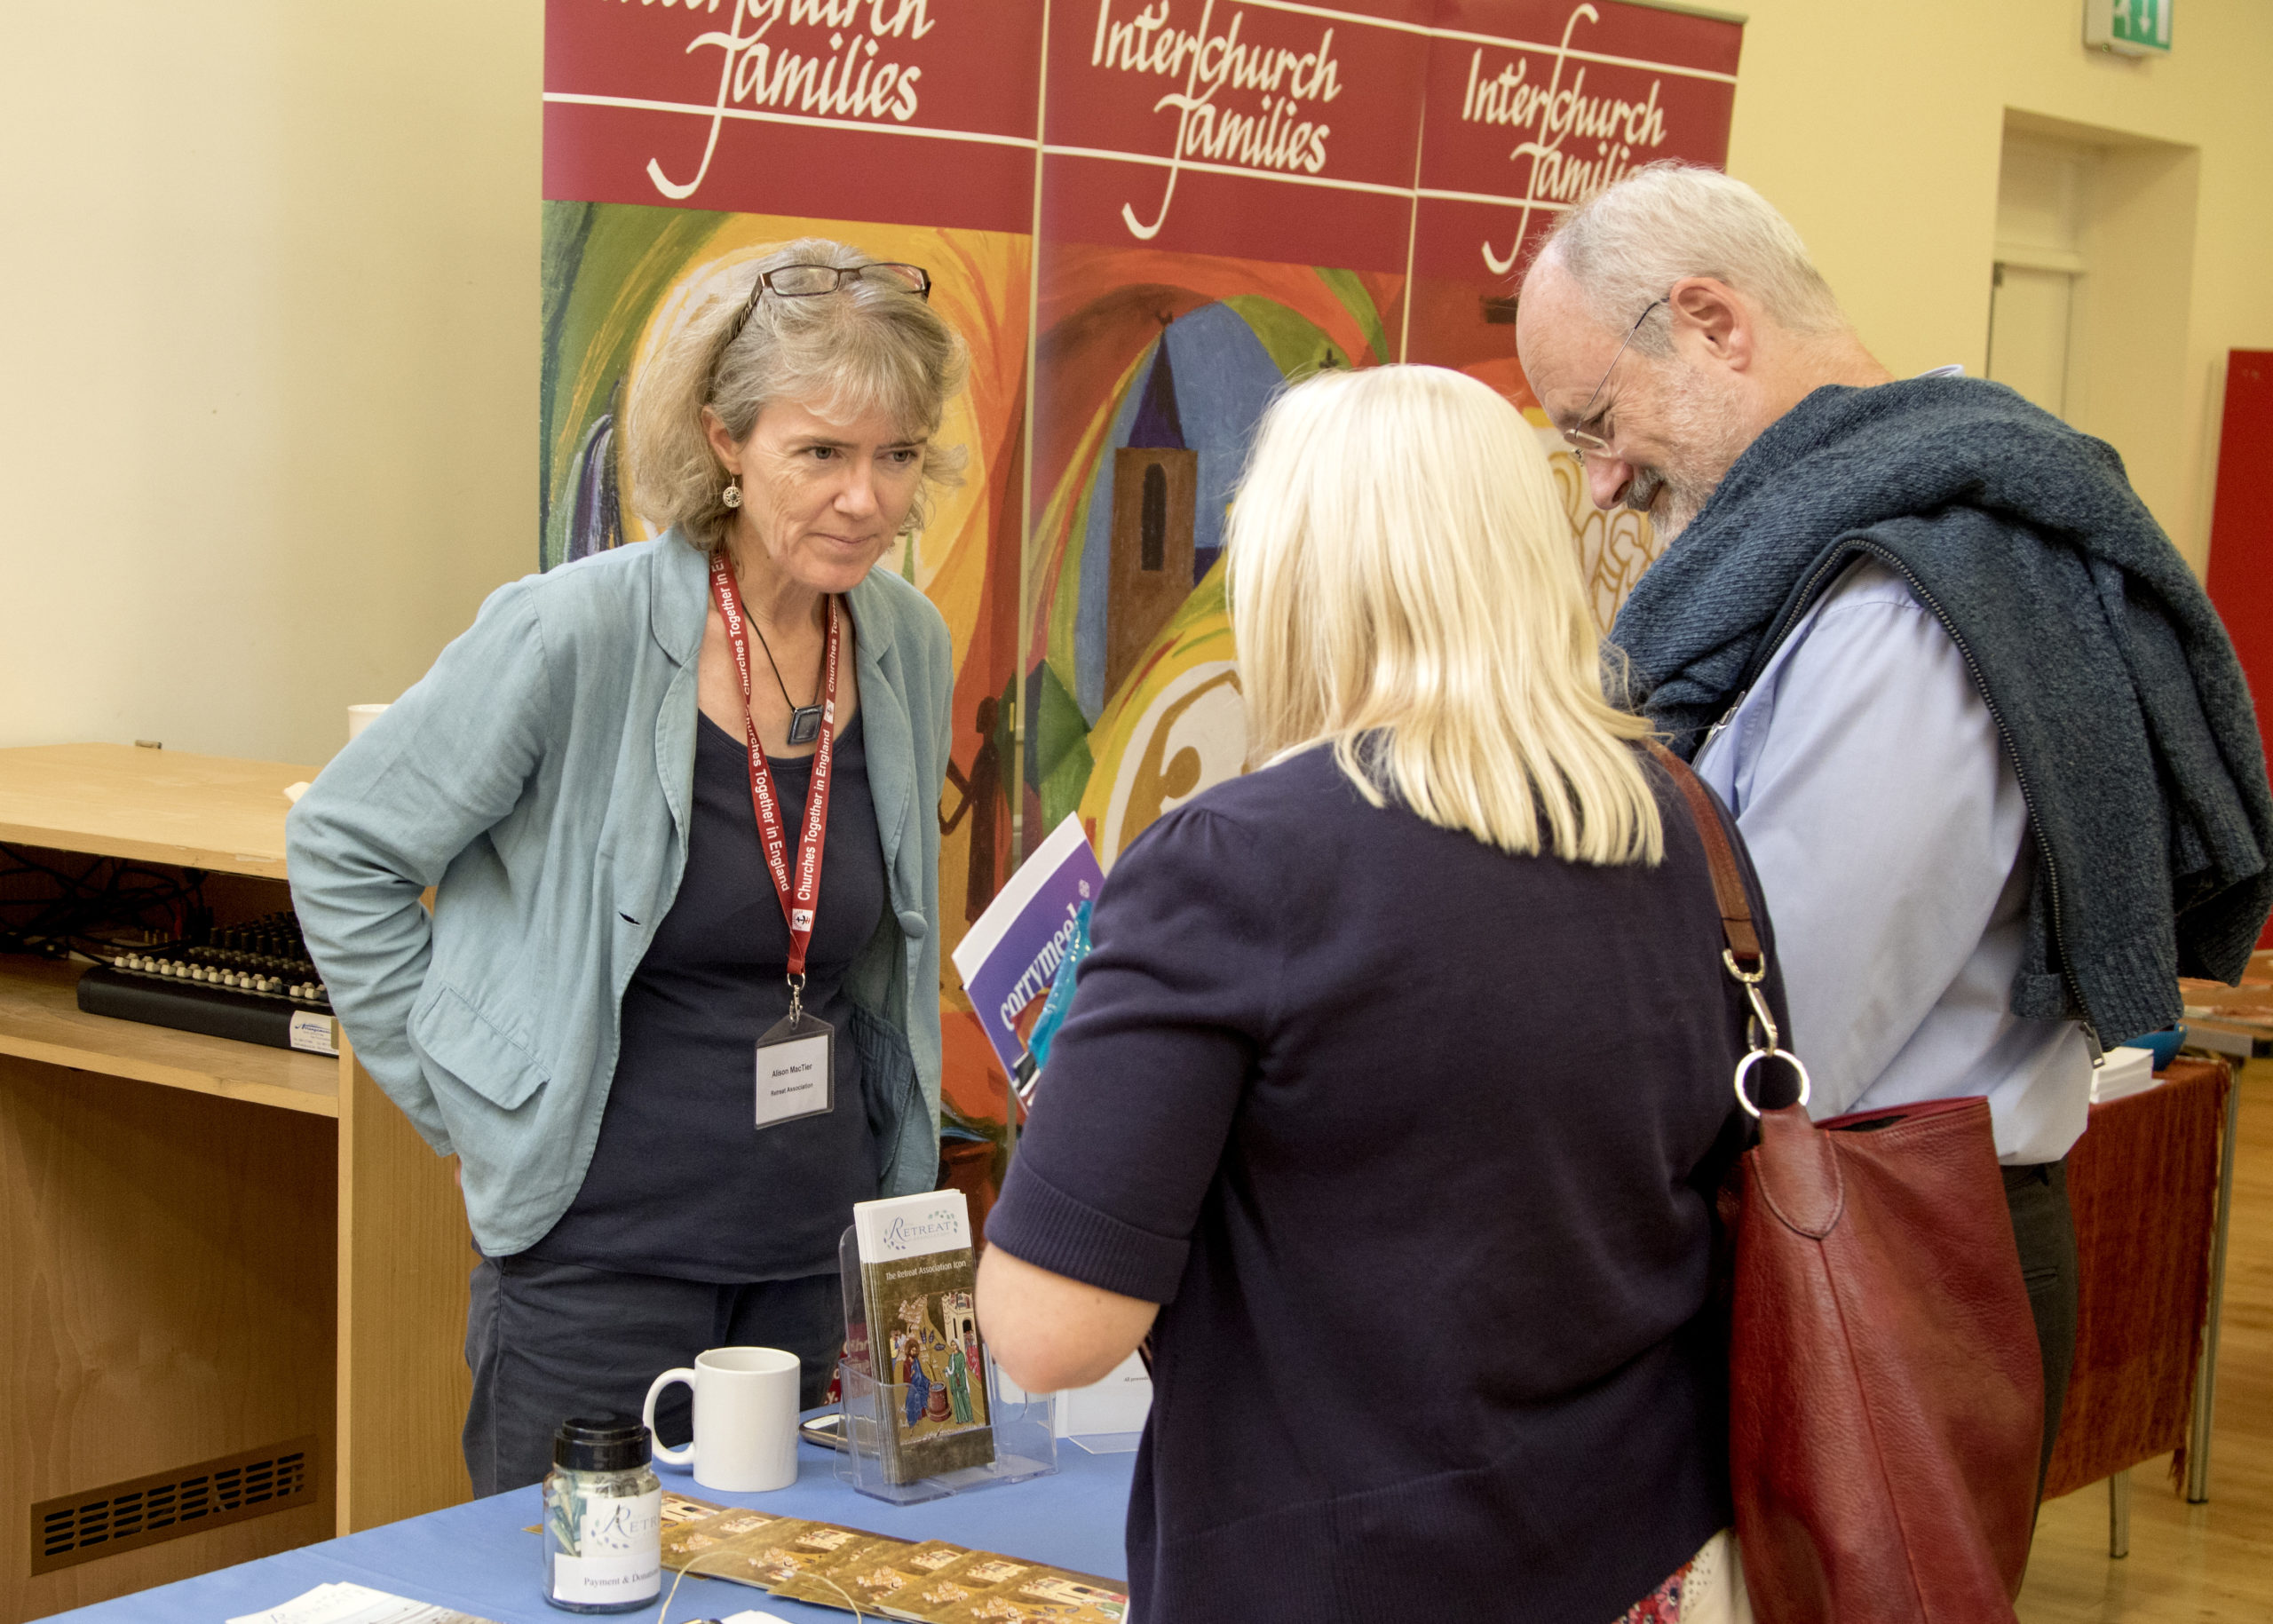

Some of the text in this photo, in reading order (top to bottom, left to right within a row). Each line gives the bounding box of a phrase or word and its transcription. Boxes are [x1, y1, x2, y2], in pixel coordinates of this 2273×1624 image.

[1092, 0, 1342, 102] Interchurch
[1462, 48, 1667, 147] Interchurch
[716, 573, 728, 586] in
[720, 587, 742, 638] Together
[735, 639, 750, 695] Churches
[828, 638, 837, 693] Churches
[816, 730, 830, 777] England
[755, 769, 774, 824] Together
[814, 780, 825, 792] in
[766, 826, 780, 839] in
[804, 792, 823, 844] Together
[770, 840, 789, 891] England
[797, 846, 816, 901] Churches
[772, 1068, 789, 1078] Alison
[897, 1268, 917, 1279] Retreat
[918, 1262, 952, 1274] Association
[953, 1260, 966, 1269] Icon
[584, 1578, 620, 1588] Payment
